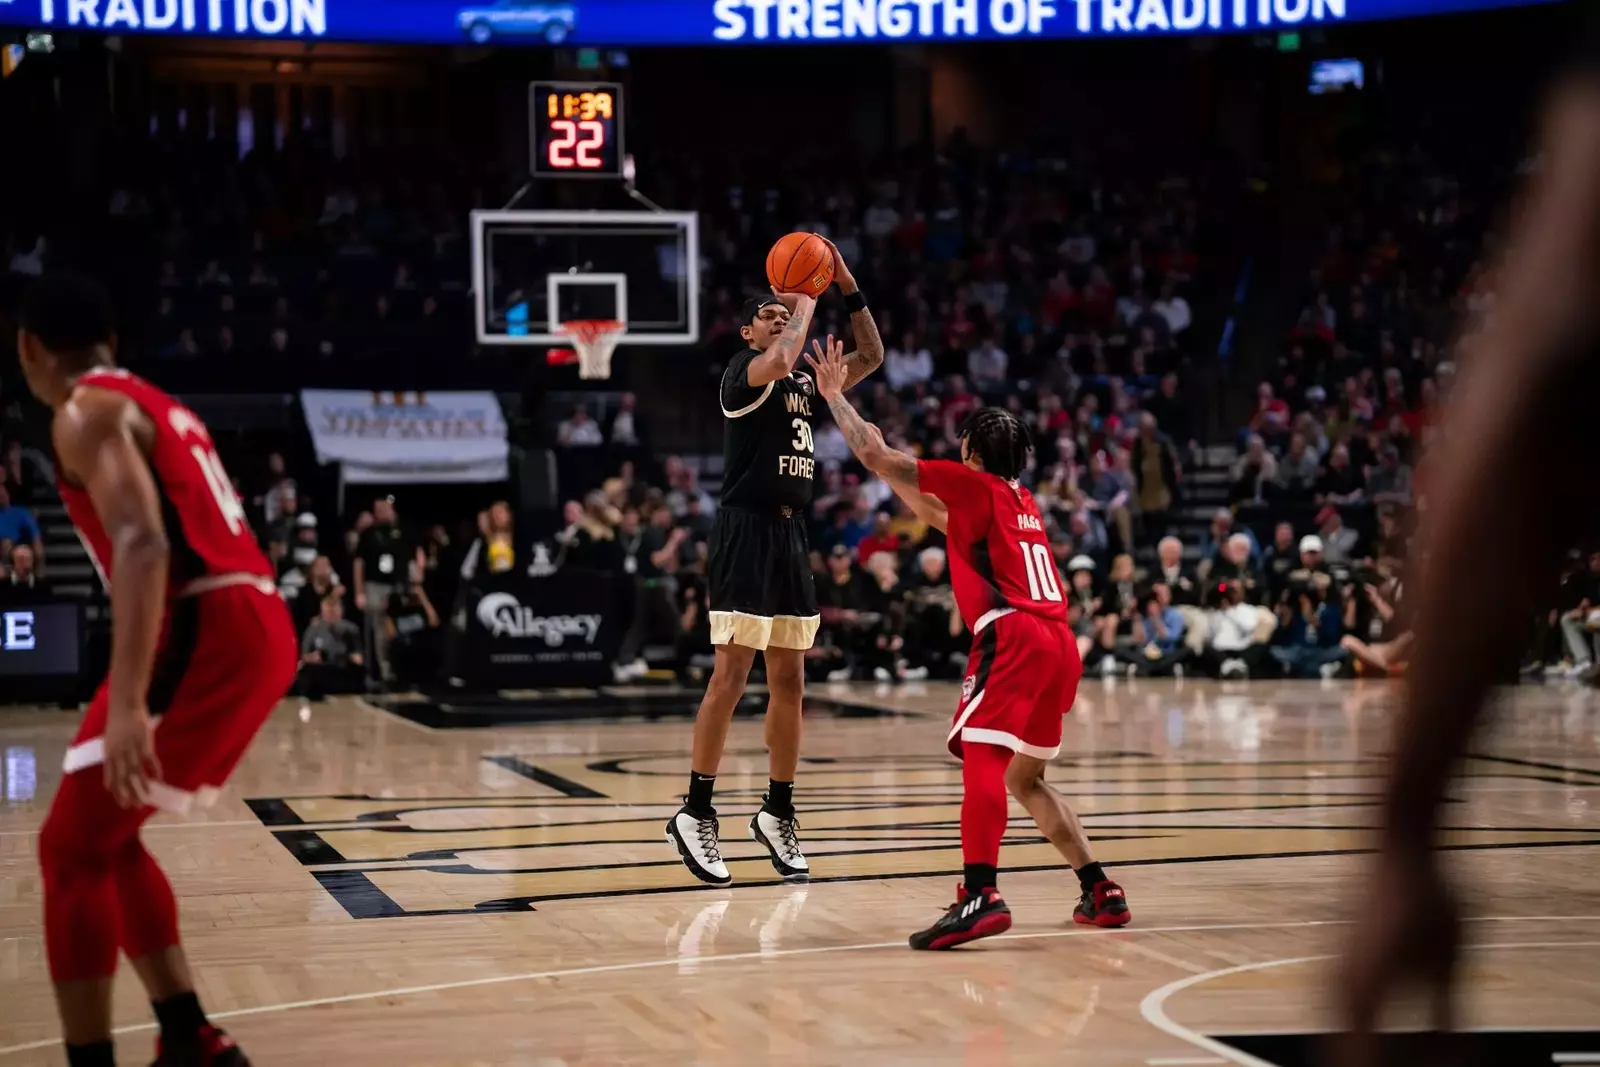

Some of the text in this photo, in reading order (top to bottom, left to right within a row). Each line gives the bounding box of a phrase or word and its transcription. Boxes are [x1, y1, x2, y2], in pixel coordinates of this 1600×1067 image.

[40, 0, 327, 35] TRADITION
[712, 0, 1347, 40] STRENGTH OF TRADITION
[547, 92, 612, 120] 11:39
[549, 120, 603, 168] 22
[791, 418, 815, 453] 30
[1017, 513, 1042, 531] PASS
[1018, 541, 1063, 602] 10
[0, 611, 36, 651] E
[492, 605, 602, 647] Allegacy
